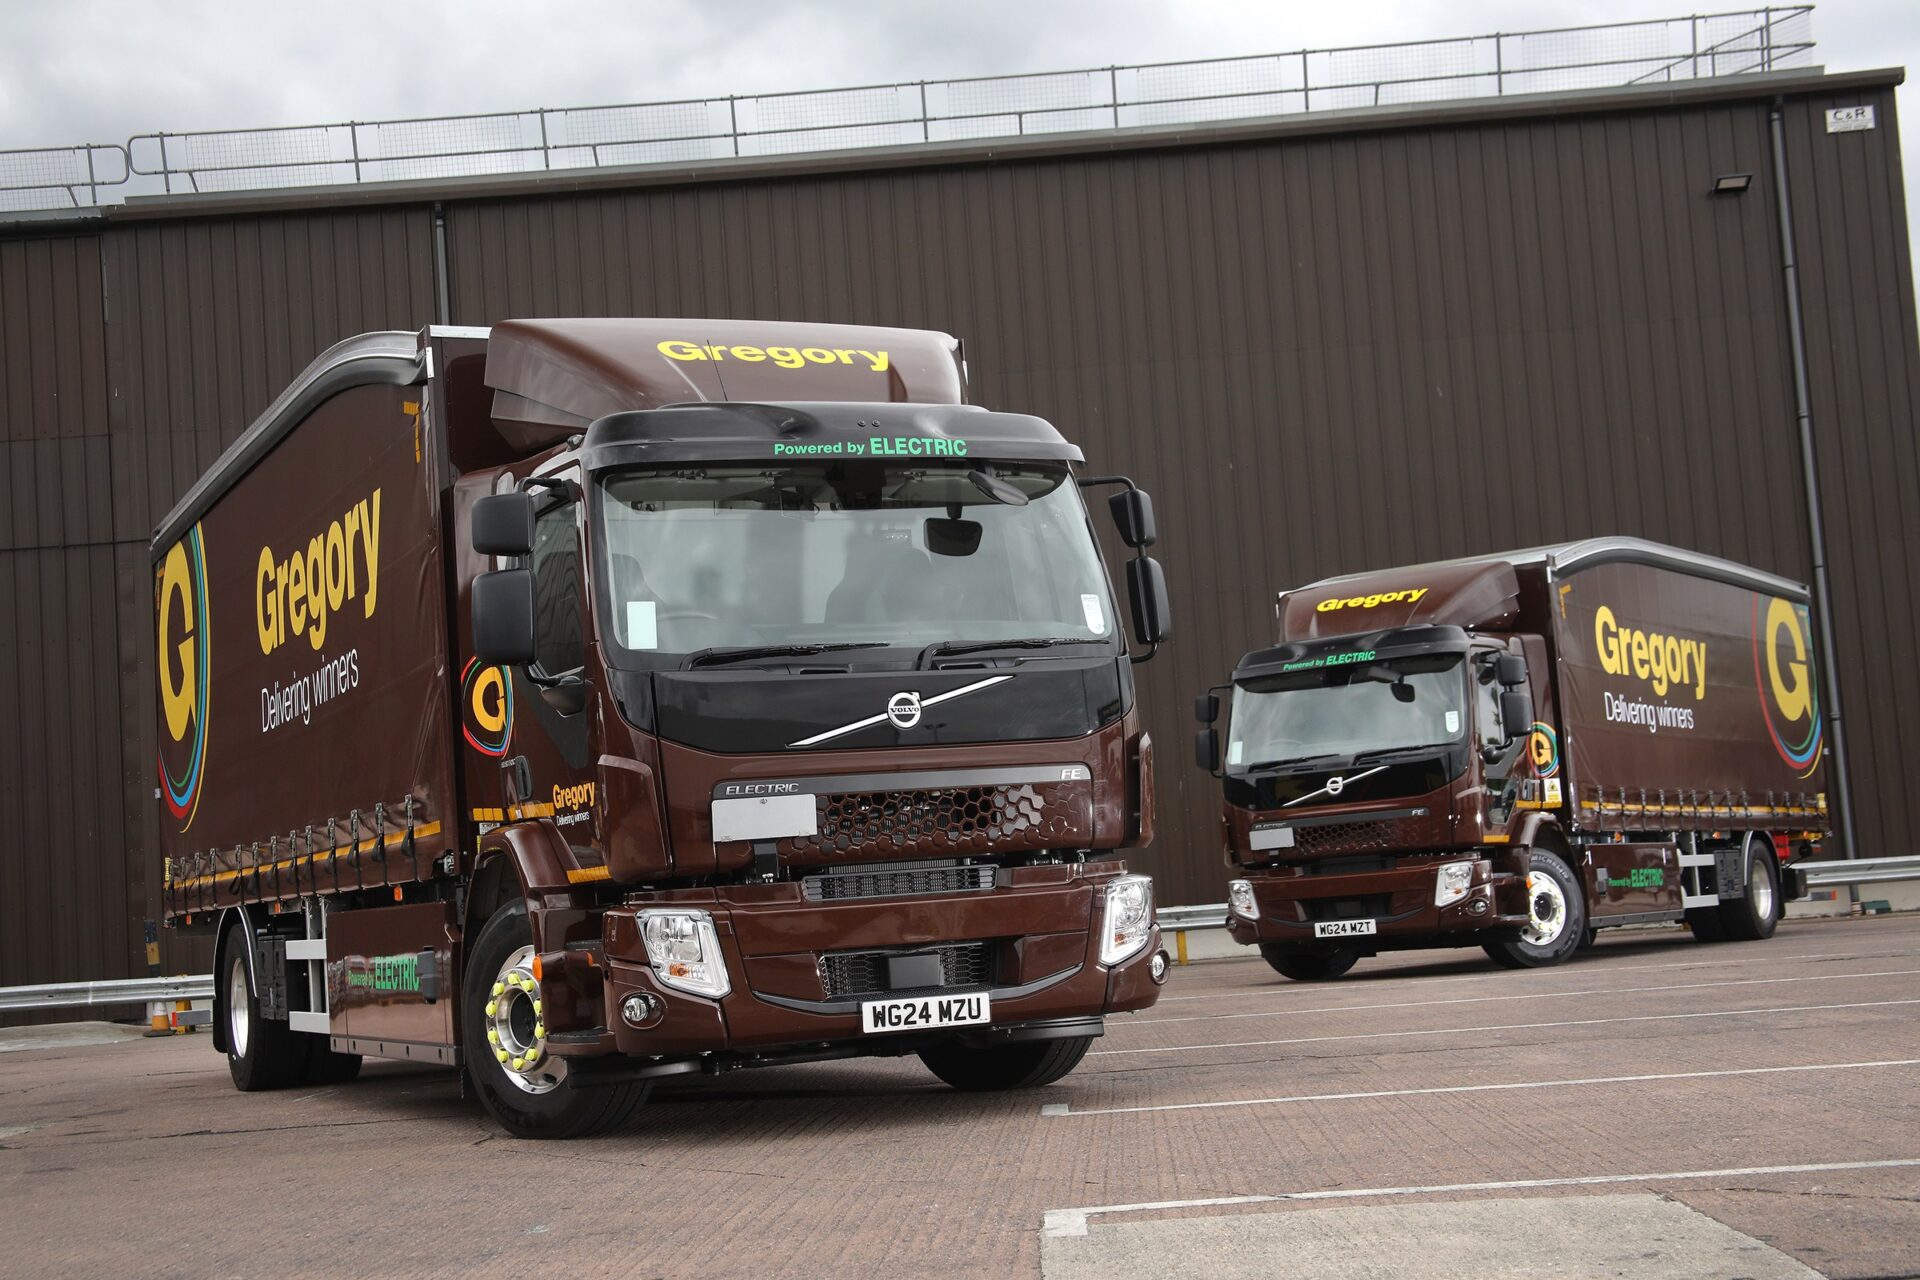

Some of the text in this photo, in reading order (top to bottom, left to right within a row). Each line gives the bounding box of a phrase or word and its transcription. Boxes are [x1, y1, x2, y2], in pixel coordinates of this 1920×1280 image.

[656, 341, 889, 371] Gregory
[774, 438, 967, 456] Powered by ELECTRIC
[257, 488, 381, 655] Gregory
[1315, 588, 1429, 613] Gregory
[1283, 660, 1315, 671] Powered
[1326, 651, 1376, 665] ELECTRIC
[1595, 605, 1706, 700] Gregory
[261, 648, 359, 733] Delivering winners
[1604, 691, 1694, 733] Delivering winners
[726, 783, 799, 795] ELECTRIC
[1061, 769, 1081, 780] FE
[553, 782, 595, 811] Gregory
[556, 811, 590, 826] Delivering winners
[1319, 921, 1371, 935] WG24 MZT
[348, 954, 420, 991] Powered by ELECTRIC
[872, 998, 981, 1028] WG24 MZU
